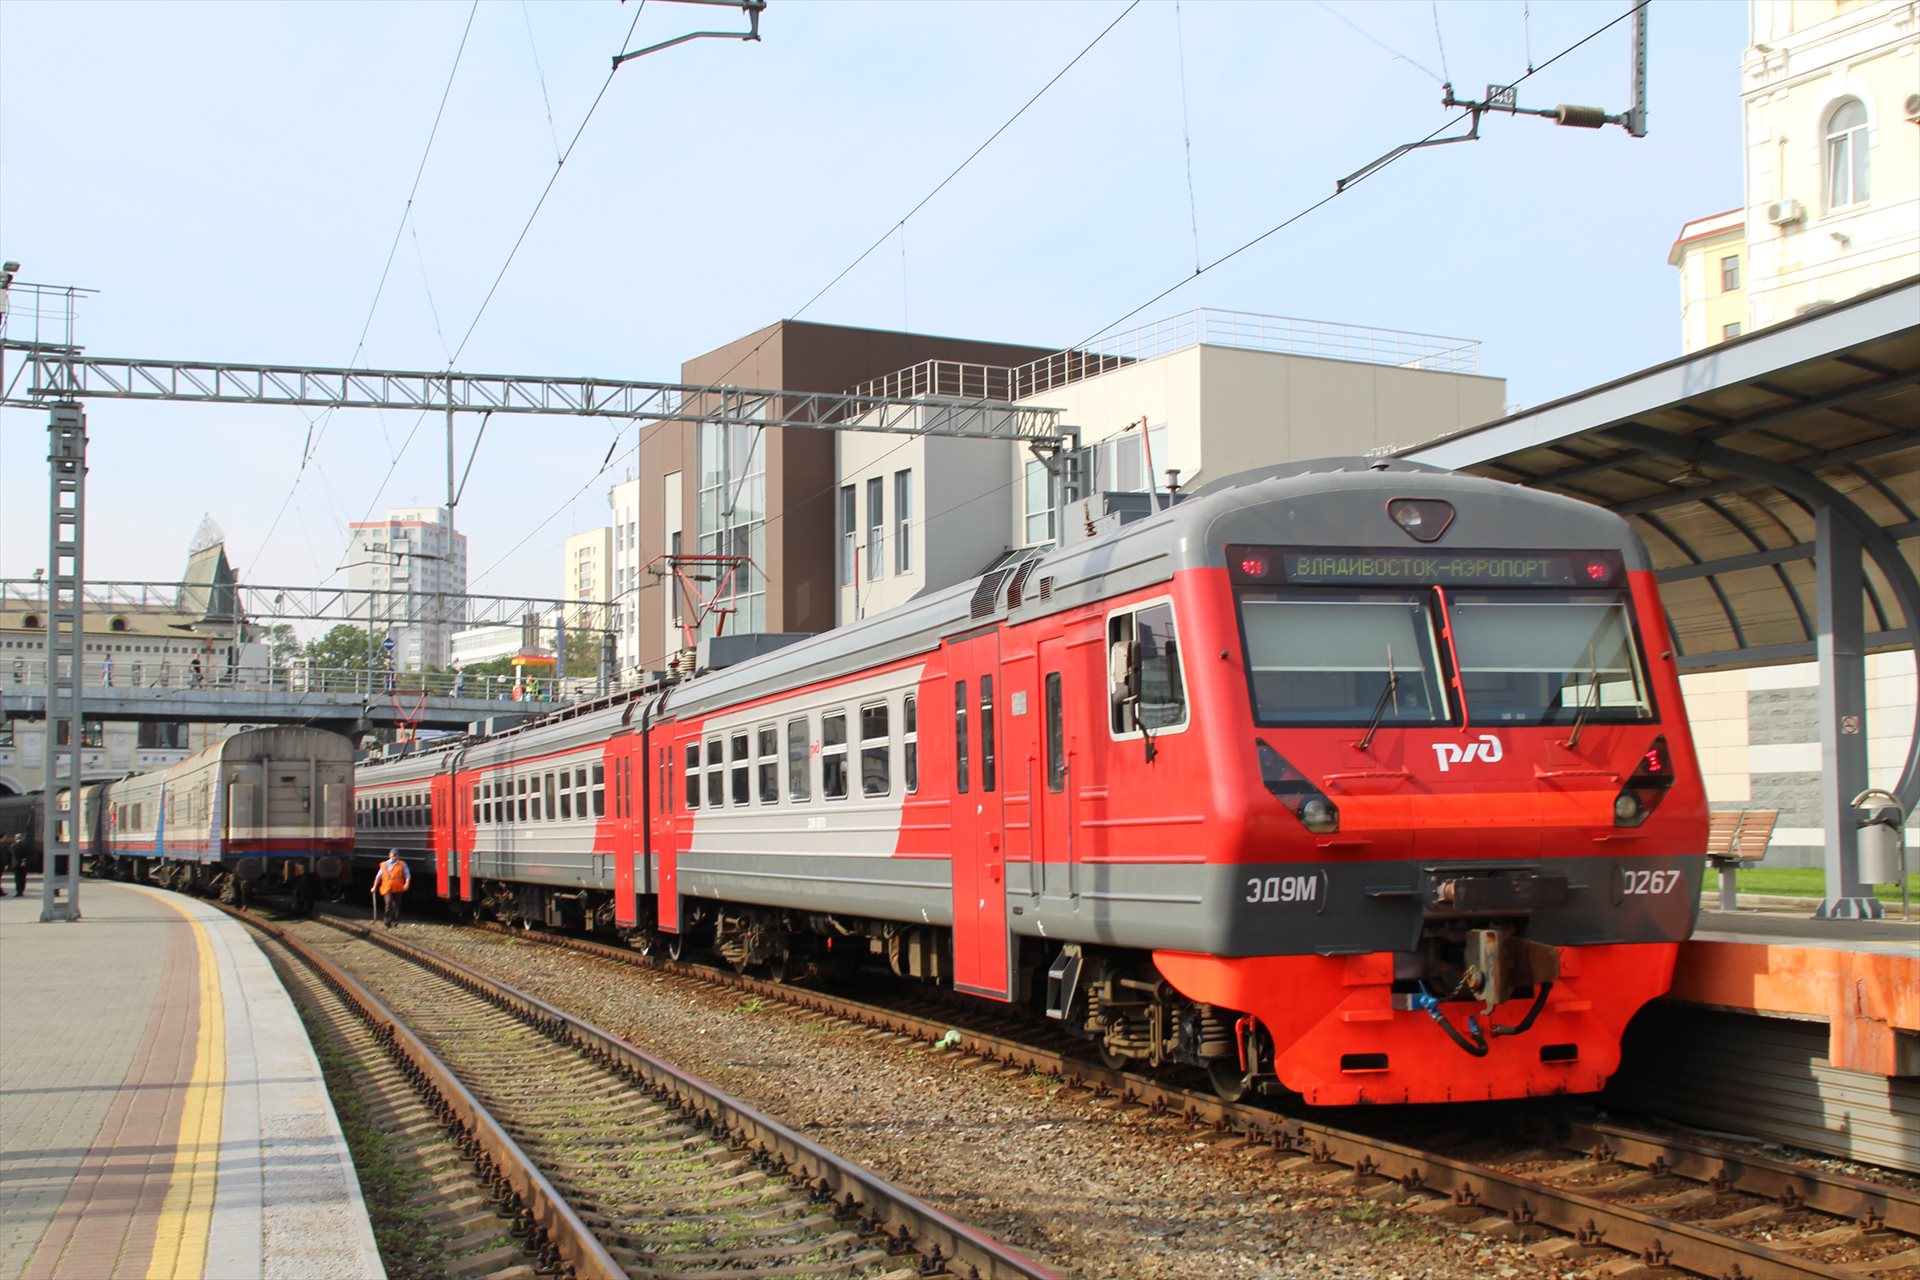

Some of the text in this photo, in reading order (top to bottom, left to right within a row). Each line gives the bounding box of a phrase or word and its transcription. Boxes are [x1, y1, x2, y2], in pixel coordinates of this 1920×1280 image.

[1296, 556, 1551, 578] ВЛАДИВОСТОК-АЭРОПОРТ
[1246, 875, 1317, 903] ЭД9М
[1623, 869, 1681, 895] 0267
